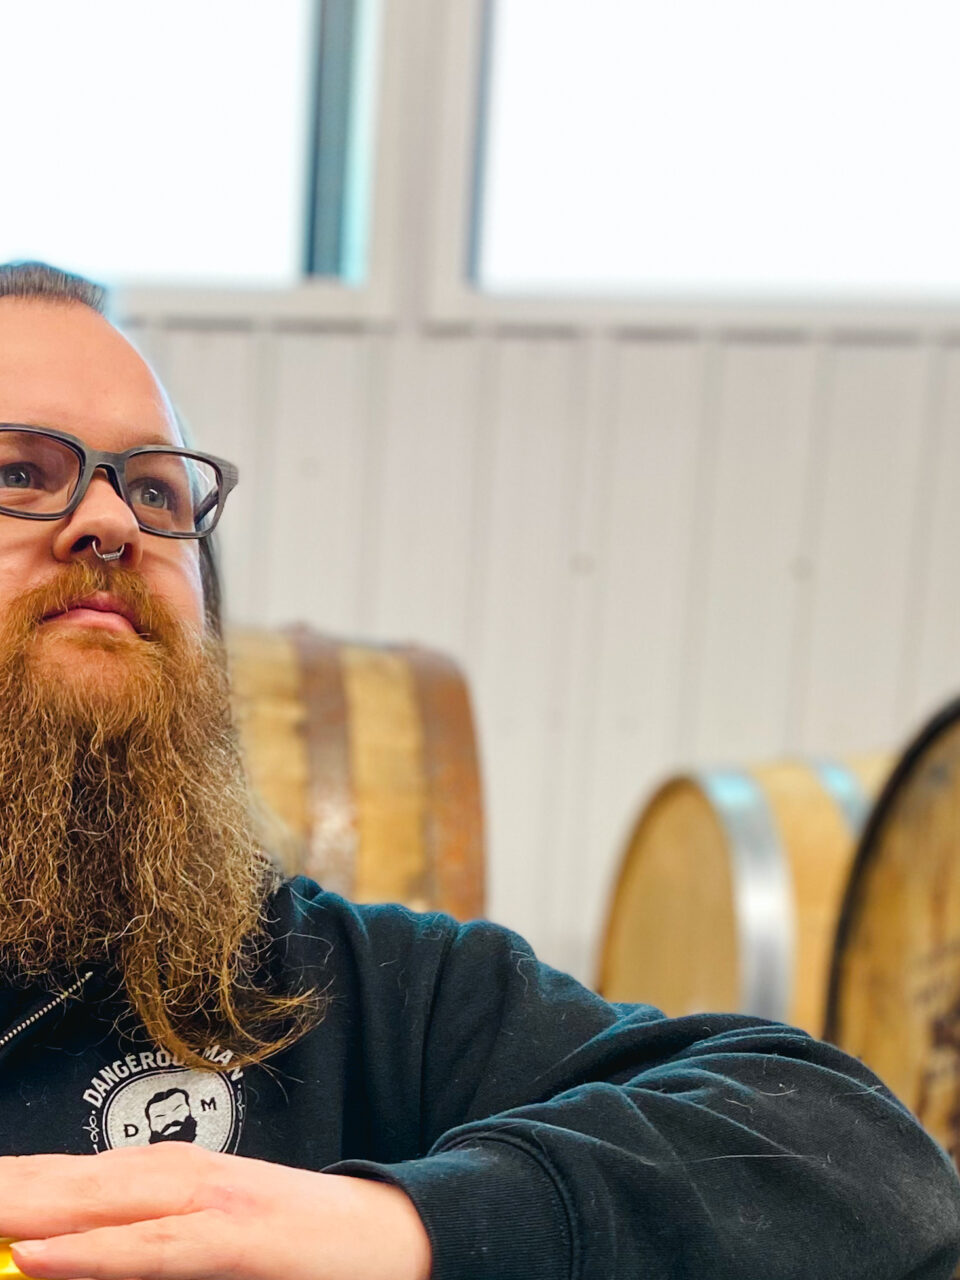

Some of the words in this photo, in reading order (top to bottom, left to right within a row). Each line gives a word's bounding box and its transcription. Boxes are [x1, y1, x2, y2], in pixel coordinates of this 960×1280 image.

[83, 1049, 200, 1109] DANGEROU
[201, 1044, 244, 1082] MAN
[123, 1123, 139, 1138] D
[200, 1097, 218, 1112] M
